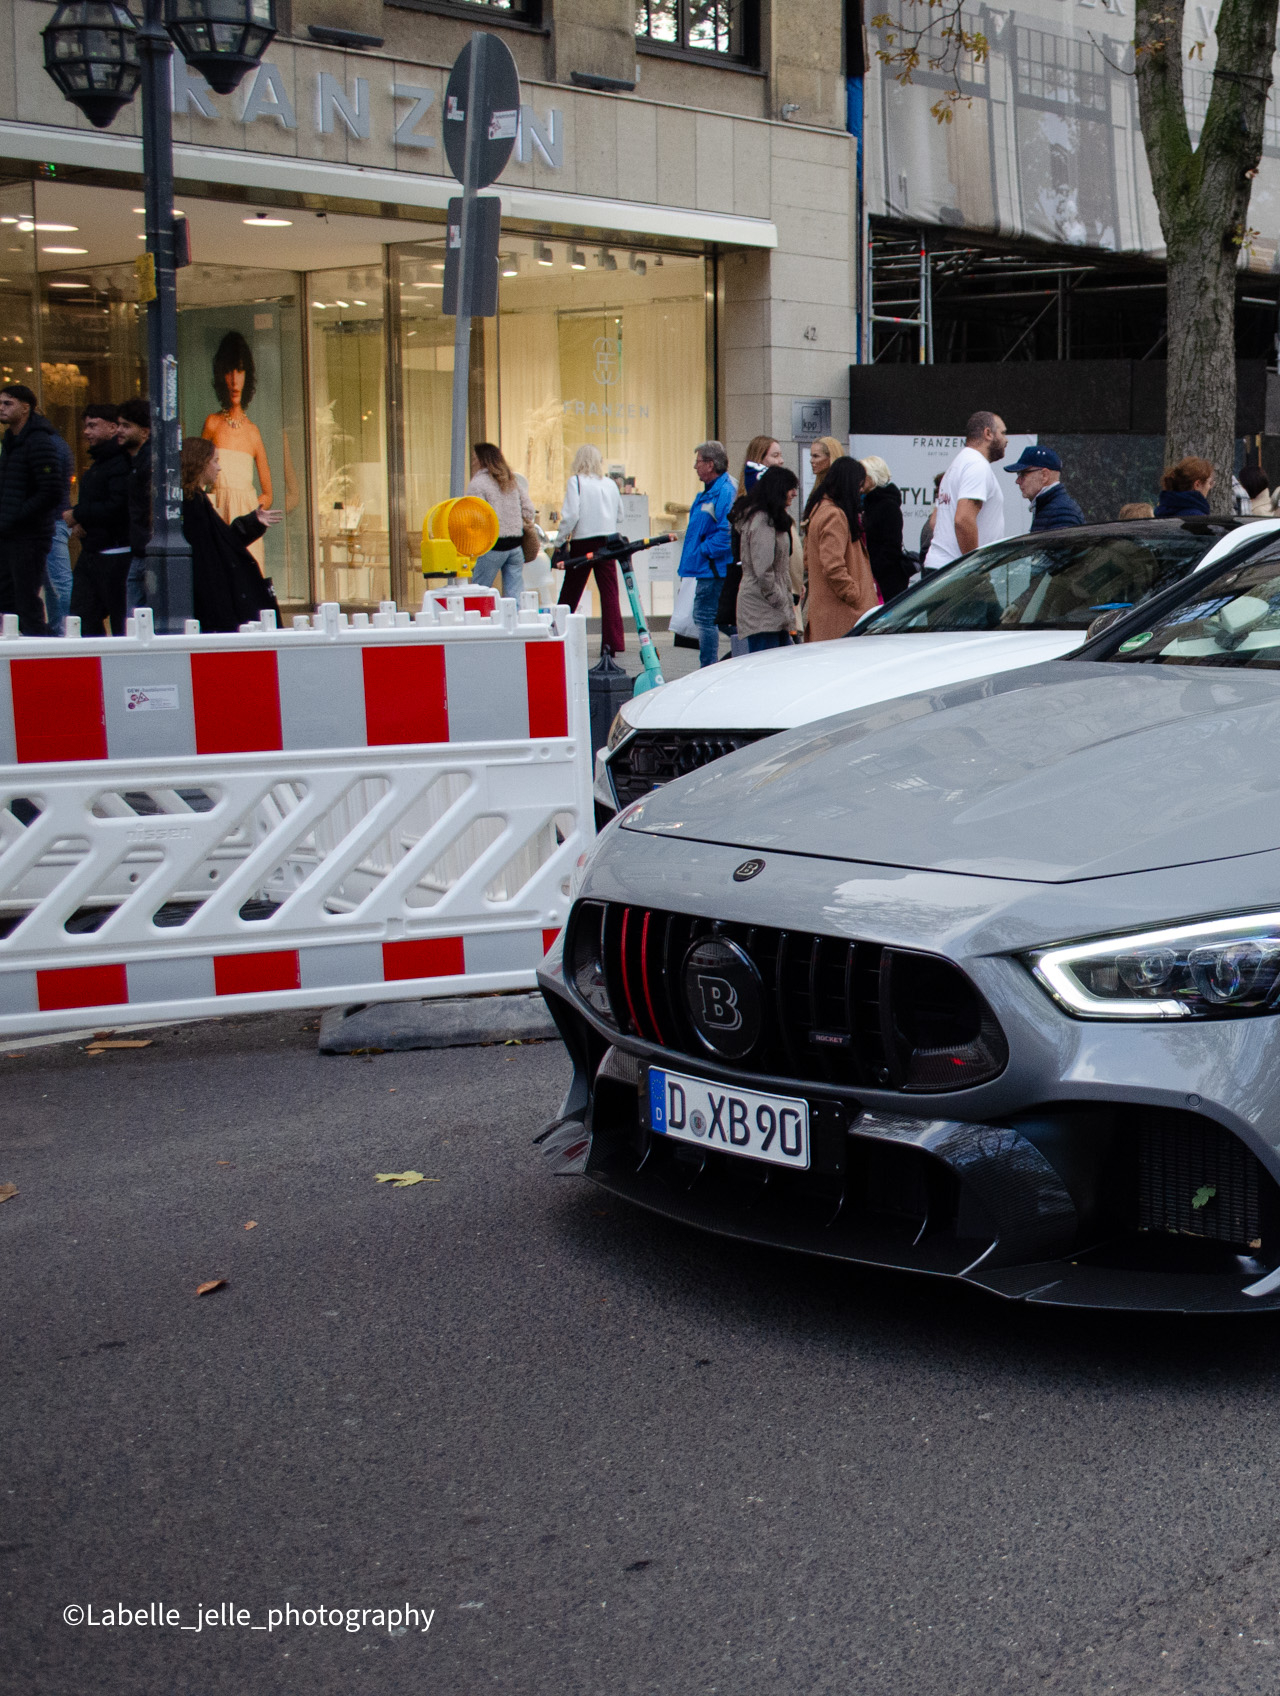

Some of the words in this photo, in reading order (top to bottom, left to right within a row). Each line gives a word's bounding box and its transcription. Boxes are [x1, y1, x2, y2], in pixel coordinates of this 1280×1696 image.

[172, 48, 563, 168] RANZN
[803, 325, 818, 341] 42
[563, 401, 649, 418] FRANZEN
[913, 438, 967, 448] FRANZEN
[900, 487, 937, 506] TYL
[126, 823, 192, 841] nissen
[736, 862, 759, 876] B
[697, 974, 742, 1031] B
[815, 1034, 844, 1044] ROCKET
[655, 1106, 663, 1121] D
[668, 1081, 686, 1130] D
